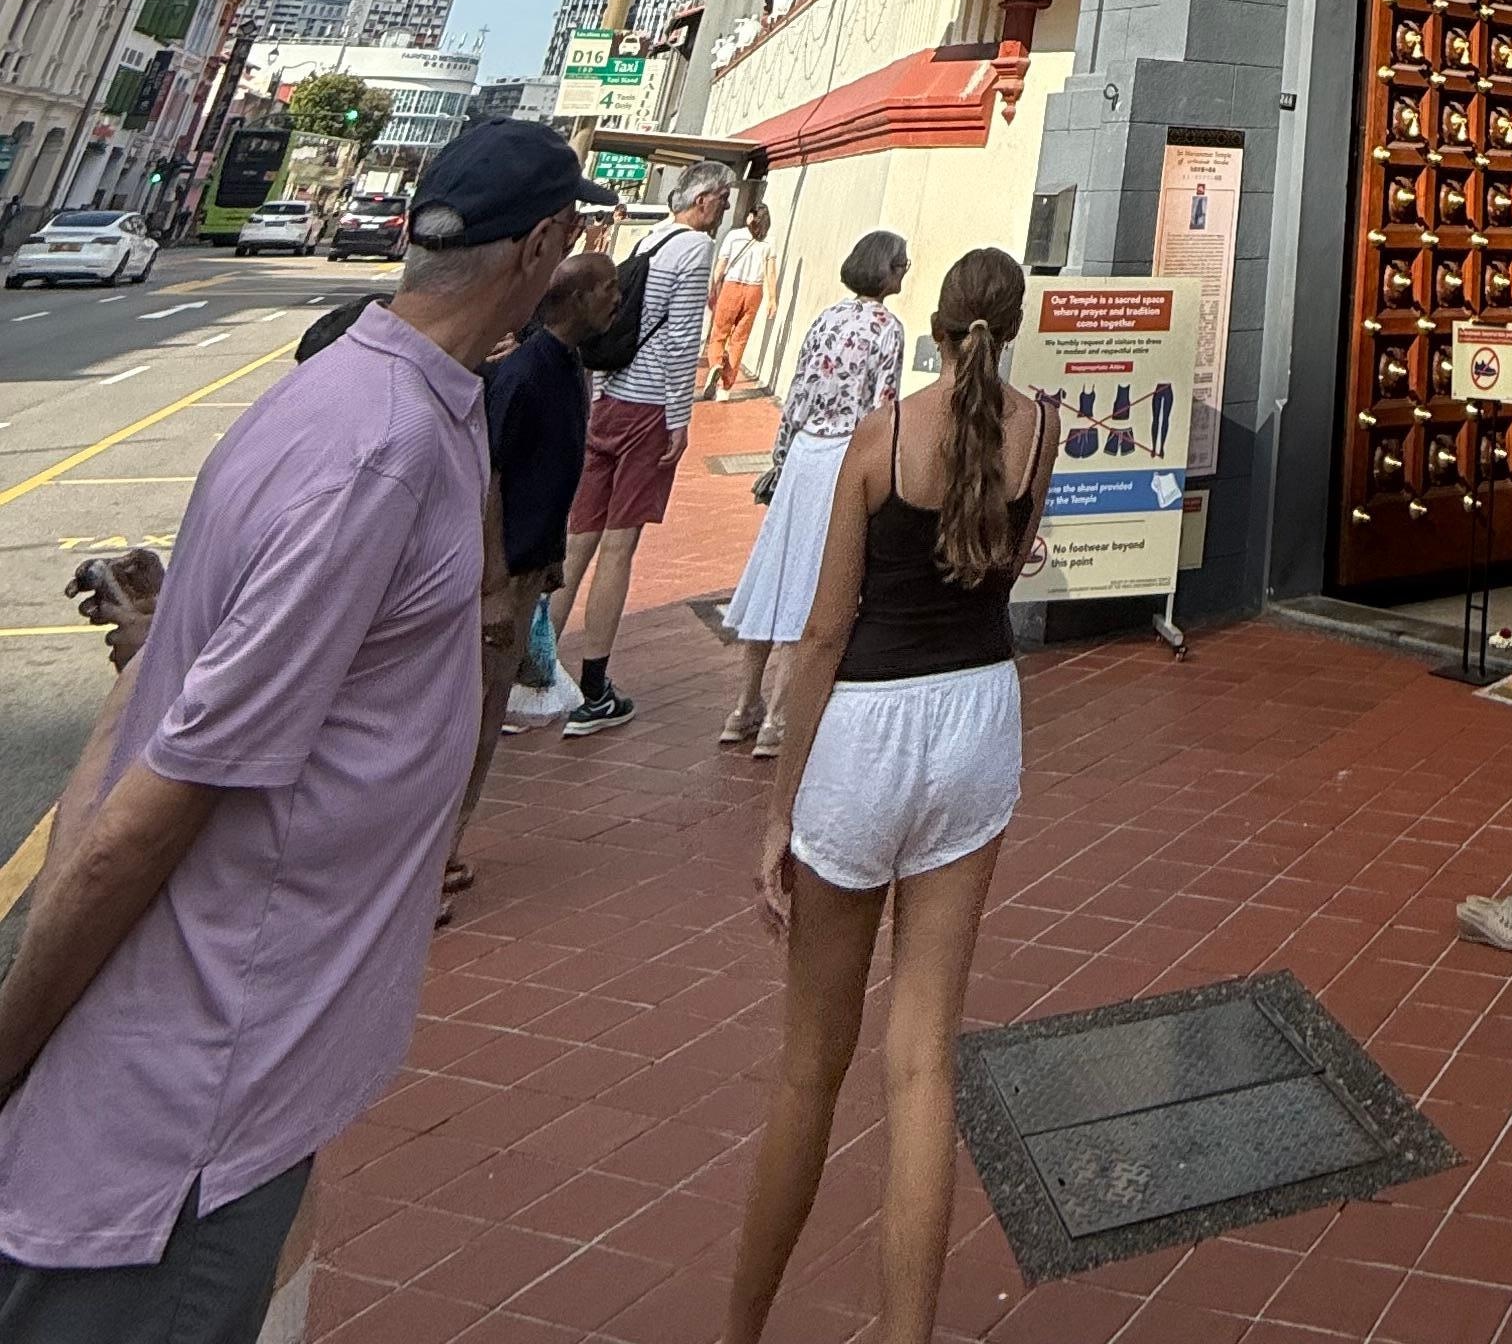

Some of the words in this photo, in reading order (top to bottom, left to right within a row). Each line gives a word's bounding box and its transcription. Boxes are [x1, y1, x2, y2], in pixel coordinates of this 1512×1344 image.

[572, 50, 604, 64] D16
[614, 60, 639, 73] Taxi
[599, 91, 614, 109] 4
[1051, 295, 1067, 304] Our
[1069, 295, 1098, 306] Temple
[1099, 295, 1106, 304] is
[1114, 294, 1141, 304] sacred
[1142, 296, 1165, 305] space
[1053, 307, 1079, 316] where
[1080, 308, 1108, 318] prayer
[1109, 306, 1125, 316] and
[1126, 306, 1160, 316] tradition
[1076, 320, 1099, 328] come
[1100, 318, 1136, 330] together
[1056, 339, 1079, 347] humbly
[1145, 337, 1162, 345] dress
[1062, 484, 1076, 493] the
[1077, 482, 1099, 493] shawl
[1099, 481, 1133, 494] provided
[1056, 495, 1069, 505] the
[1071, 494, 1097, 506] Temple
[57, 534, 177, 550] TAX
[1053, 544, 1067, 553] No
[1069, 542, 1110, 553] footwear
[1111, 539, 1145, 553] beyond
[1051, 558, 1067, 568] this
[1069, 556, 1094, 570] point
